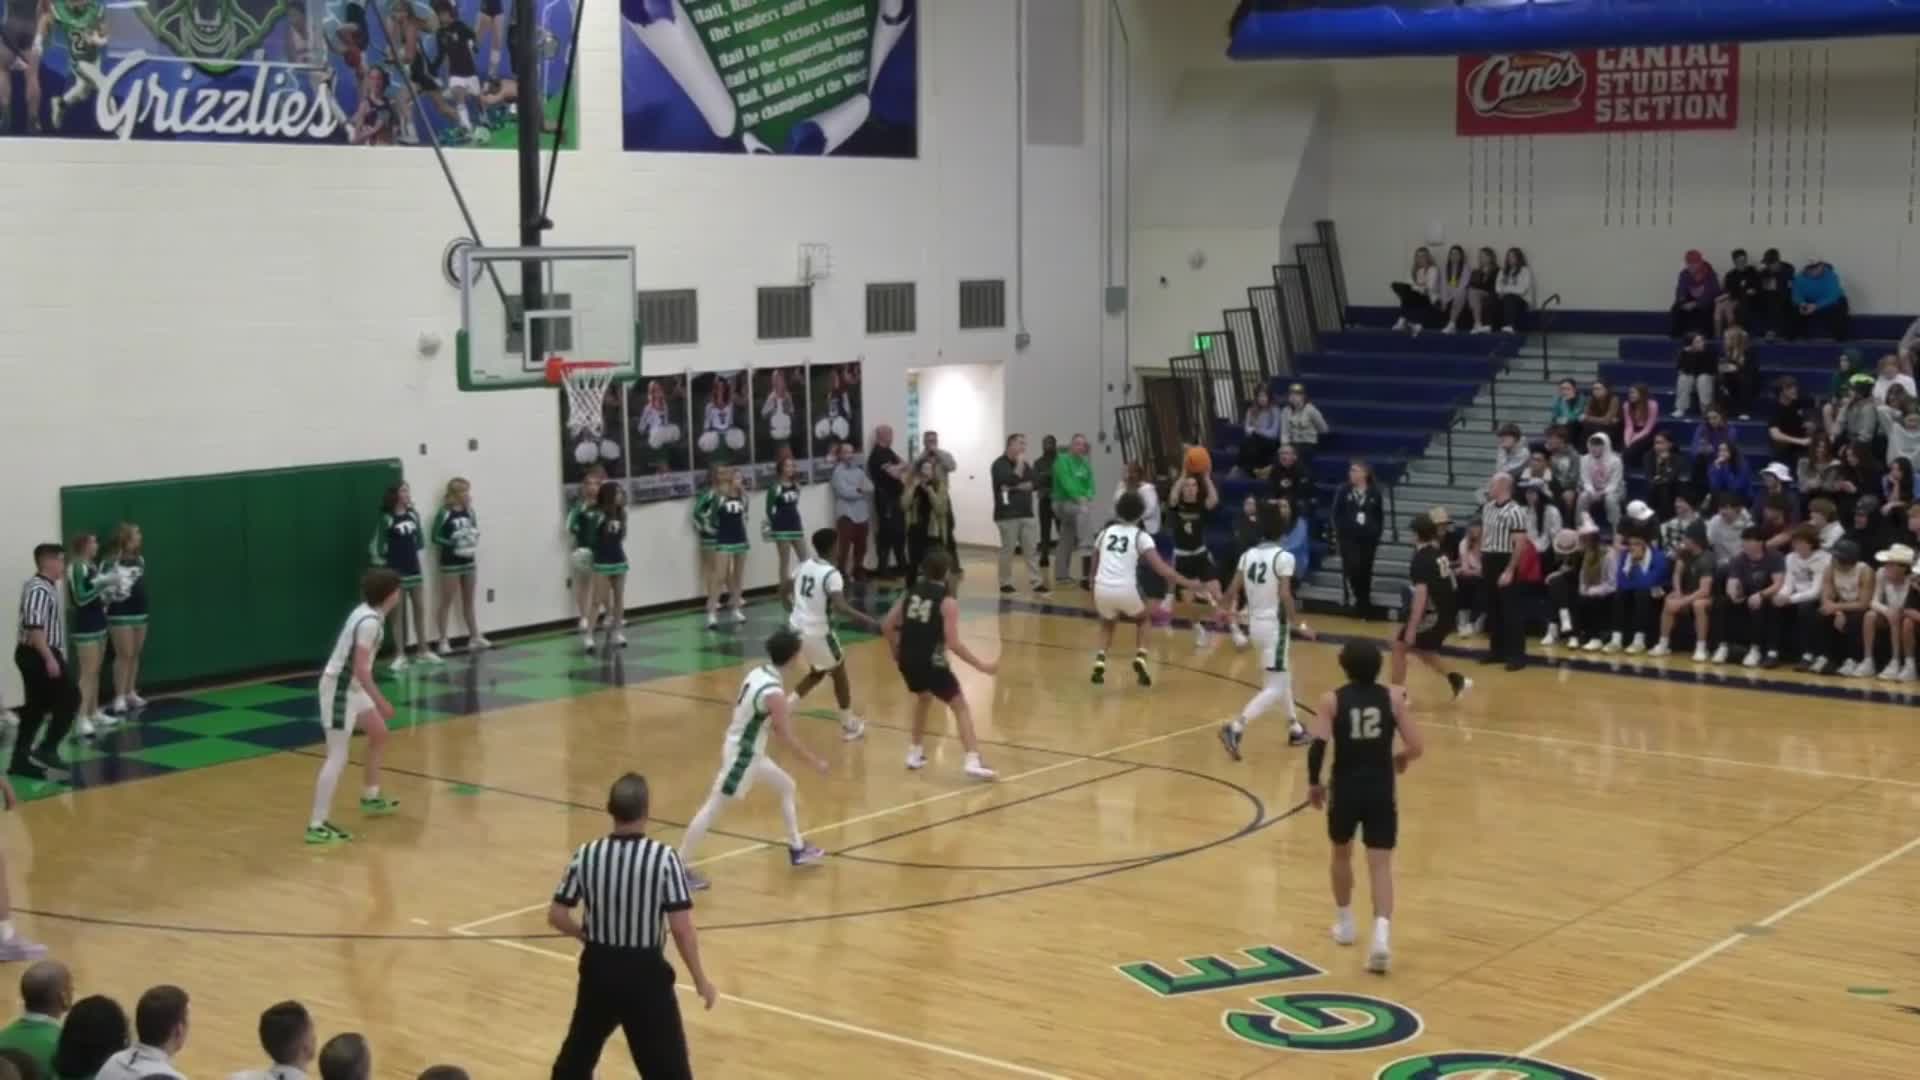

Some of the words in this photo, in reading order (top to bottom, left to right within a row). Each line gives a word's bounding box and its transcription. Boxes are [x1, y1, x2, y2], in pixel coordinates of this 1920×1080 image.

[709, 24, 732, 42] the
[733, 8, 780, 34] leaders
[718, 46, 745, 68] Hail
[745, 43, 760, 58] to
[761, 35, 781, 53] the
[782, 21, 821, 44] victors
[821, 4, 866, 29] valiant
[747, 66, 759, 80] to
[760, 59, 777, 75] the
[785, 74, 797, 89] to
[1596, 67, 1729, 96] STUDENT
[96, 50, 338, 139] Grizzlies
[742, 111, 760, 129] the
[815, 83, 826, 98] of
[826, 79, 843, 95] the
[1596, 93, 1728, 123] SECTION
[1106, 534, 1129, 553] 23
[800, 575, 815, 598] 12
[1247, 561, 1268, 584] 42
[906, 594, 933, 624] 24
[1349, 706, 1383, 739] 12
